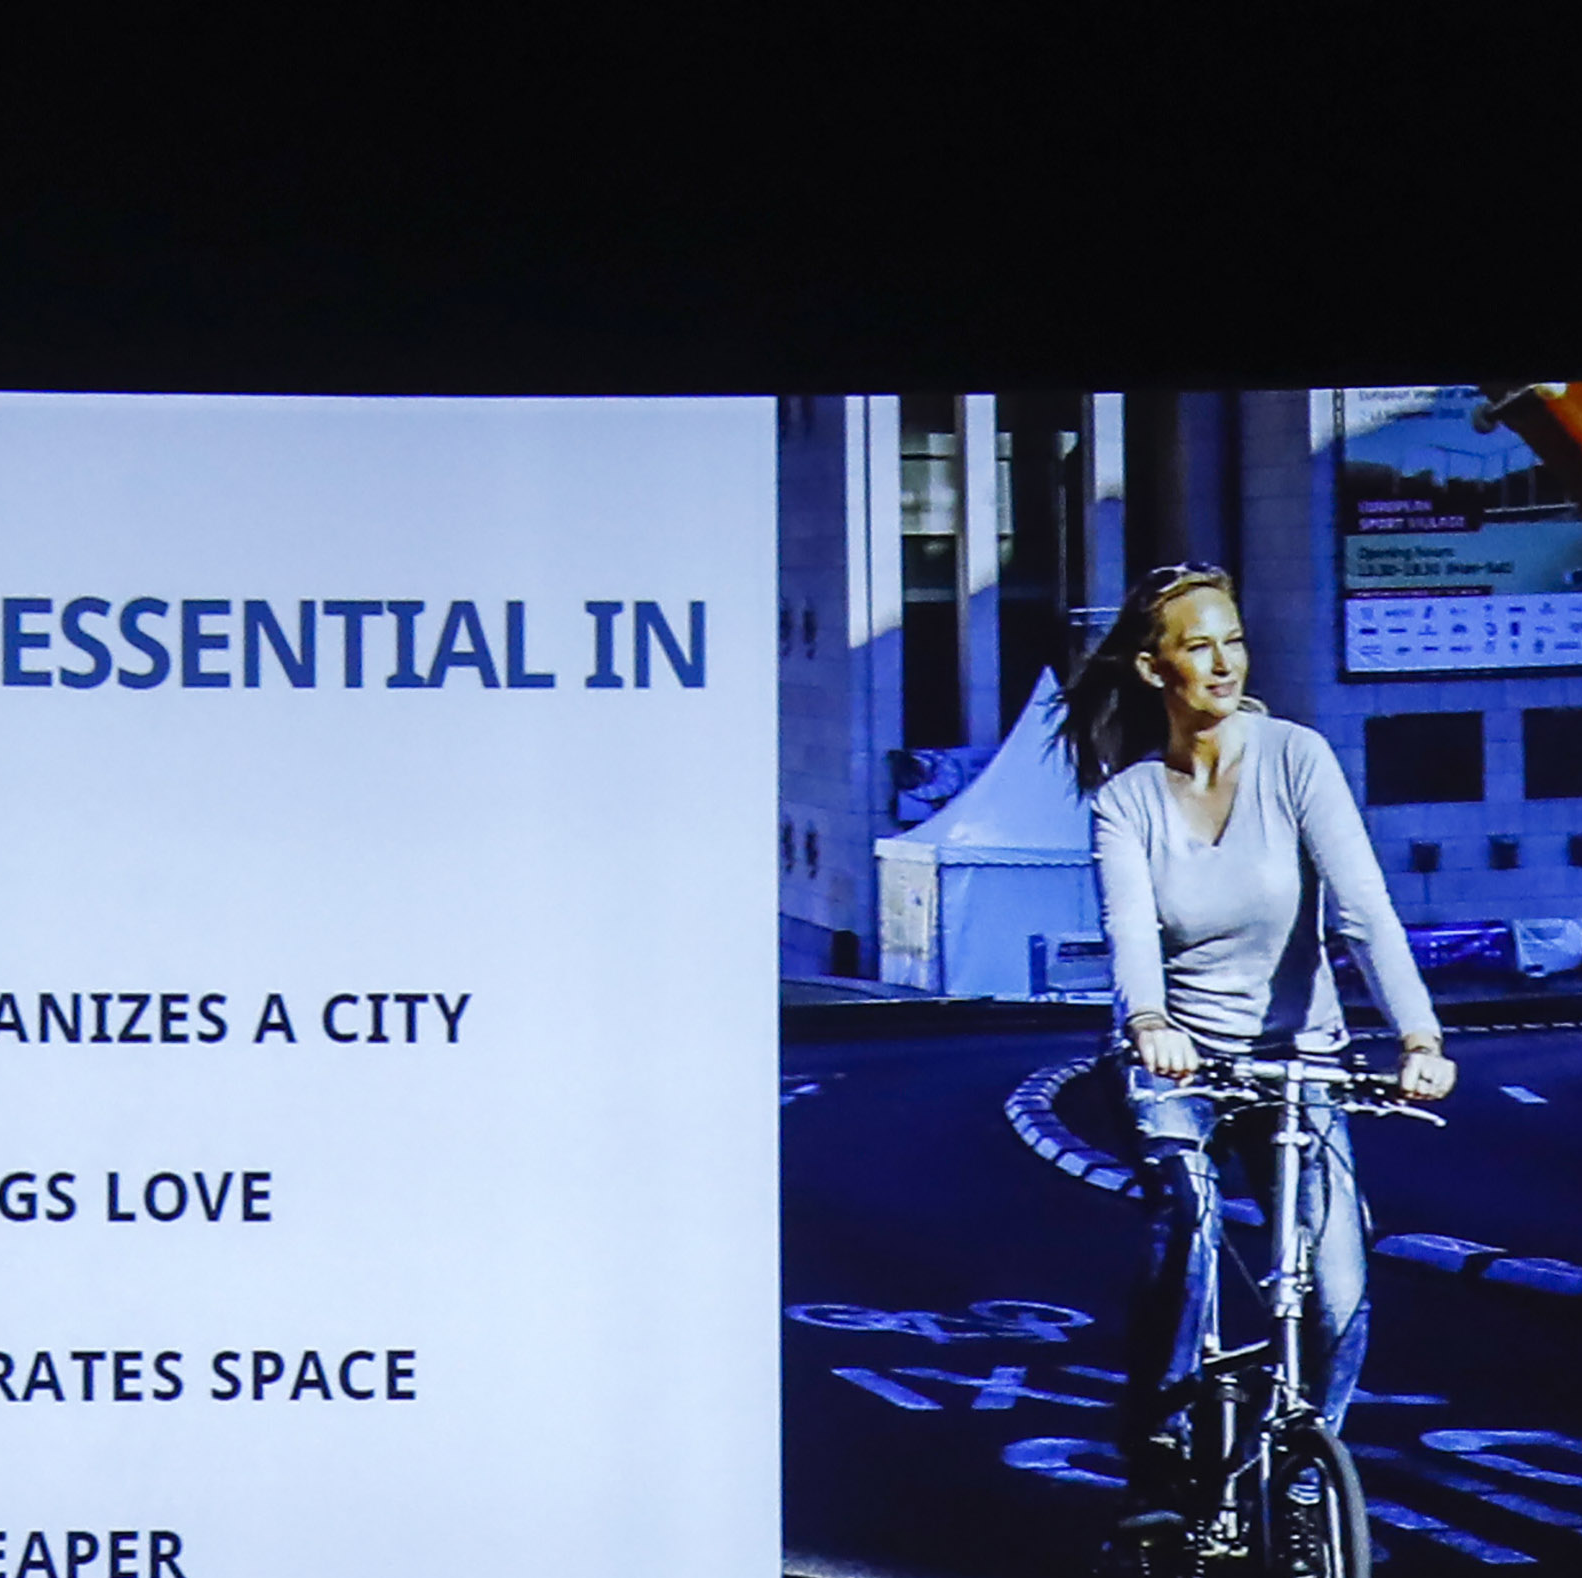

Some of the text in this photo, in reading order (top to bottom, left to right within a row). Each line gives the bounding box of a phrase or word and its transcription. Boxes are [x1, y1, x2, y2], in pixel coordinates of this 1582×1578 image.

[2, 596, 556, 689] ESSENTIAL
[585, 601, 706, 689] IN
[253, 993, 297, 1043] A
[322, 993, 472, 1043] CITY
[107, 1171, 272, 1222] LOVE
[211, 1350, 416, 1401] SPACE
